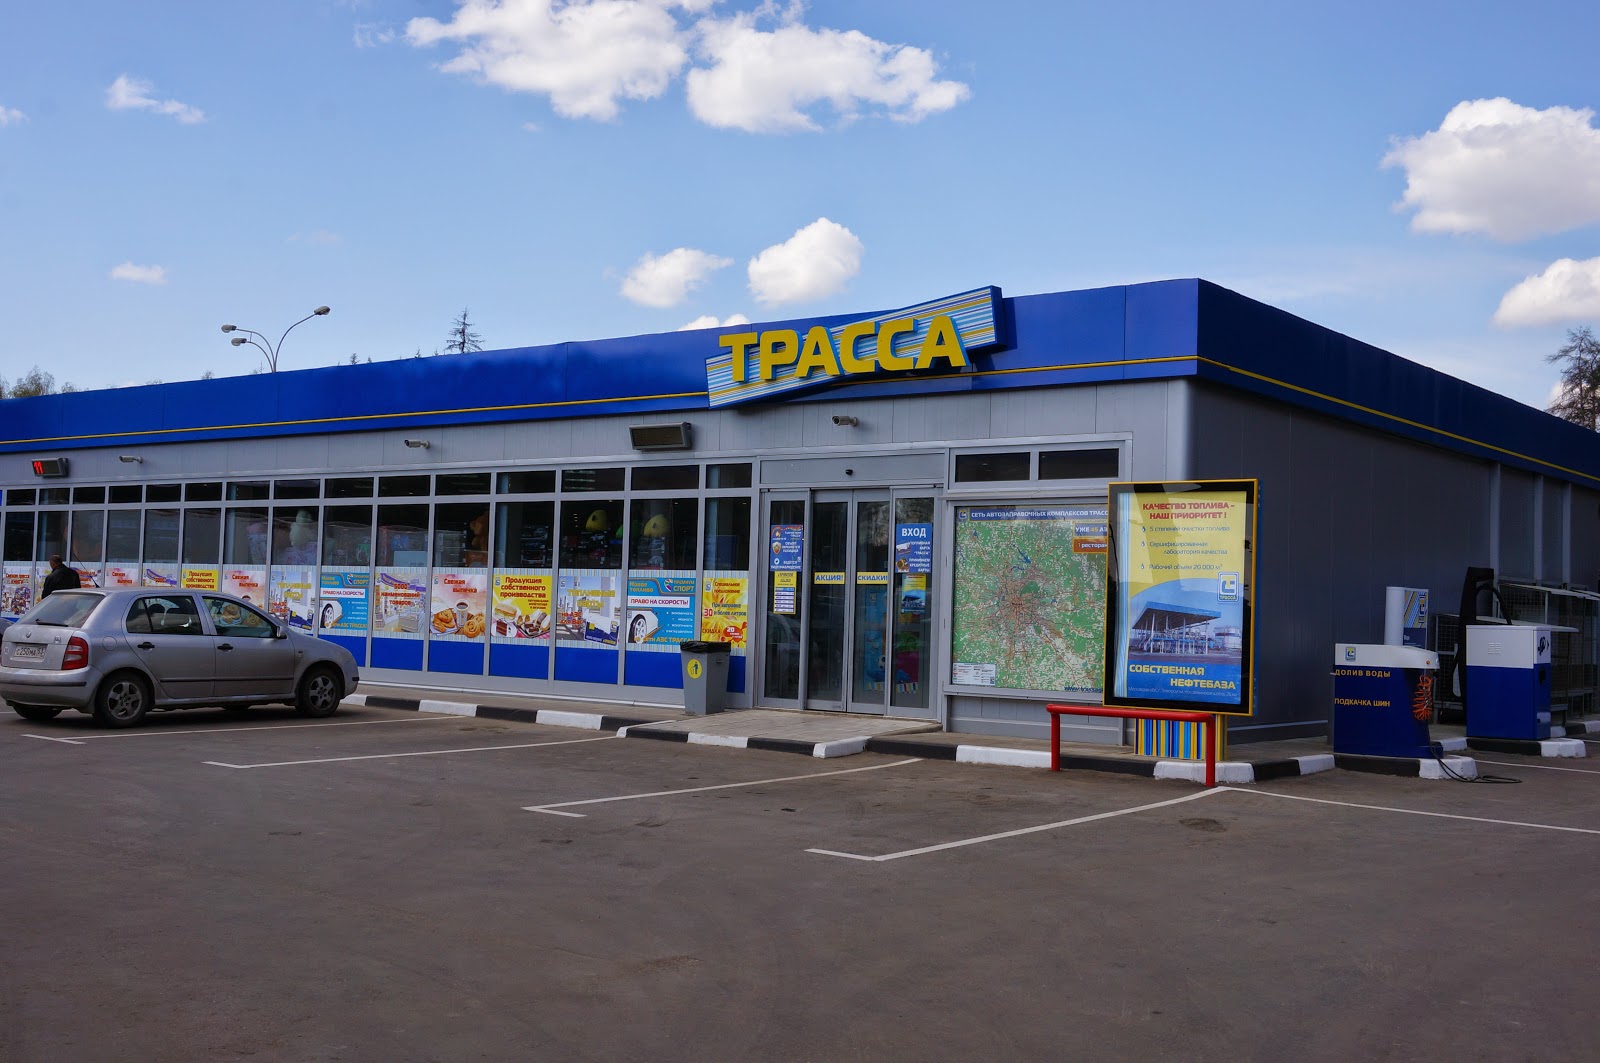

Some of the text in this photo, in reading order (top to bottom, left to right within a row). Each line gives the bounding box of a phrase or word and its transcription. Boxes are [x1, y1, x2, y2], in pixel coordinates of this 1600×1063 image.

[718, 315, 971, 383] ТРАССА
[986, 510, 1047, 518] АВТОЗАПРАВОЧНЫХ
[1149, 512, 1169, 520] НАШ
[901, 527, 926, 538] ВХОД
[505, 576, 542, 584] Продукция
[1129, 664, 1205, 675] СОБСТВЕННАЯ
[1366, 669, 1390, 677] ВОДЫ
[1170, 678, 1236, 689] НЕФТЕБАЗА
[1334, 698, 1371, 706] ПОДКАЧКА
